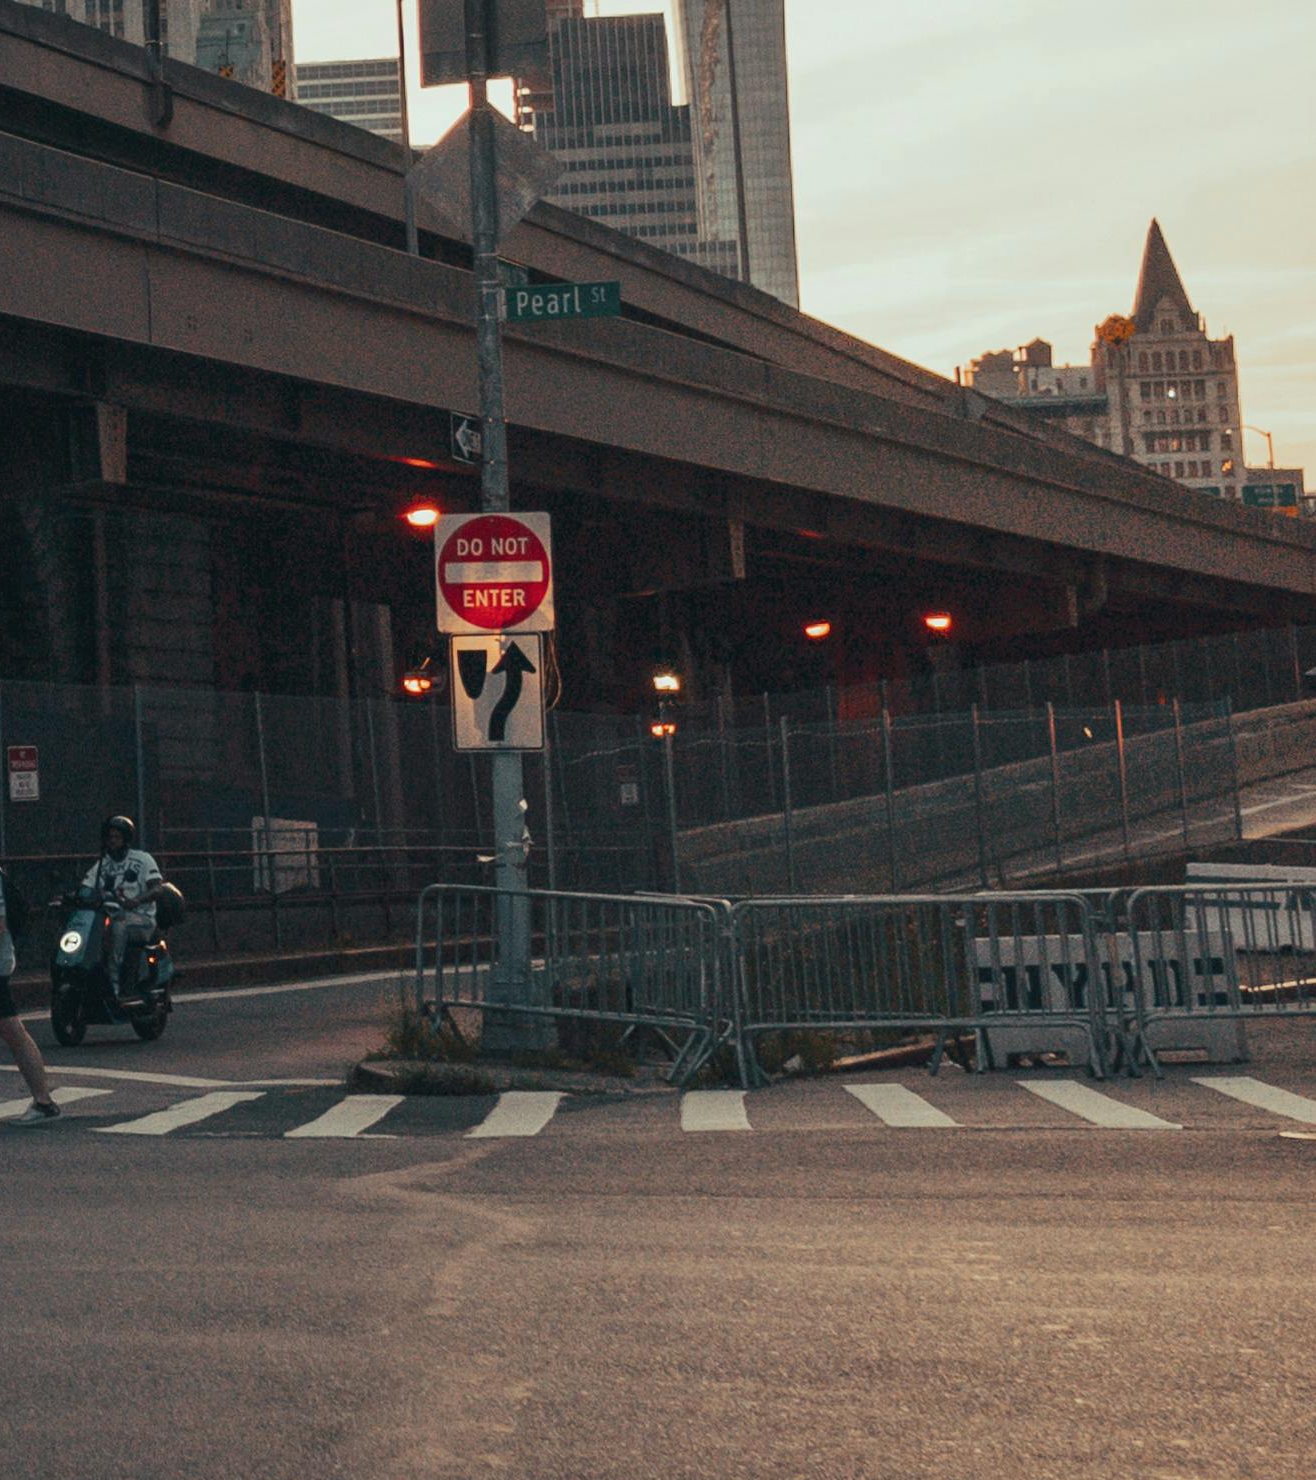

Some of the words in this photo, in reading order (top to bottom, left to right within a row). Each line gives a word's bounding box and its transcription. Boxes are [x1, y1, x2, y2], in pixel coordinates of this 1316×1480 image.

[516, 286, 581, 316] Pearl
[591, 287, 606, 303] St
[457, 538, 483, 557] DO
[491, 537, 528, 556] NOT
[463, 588, 526, 608] ENTER
